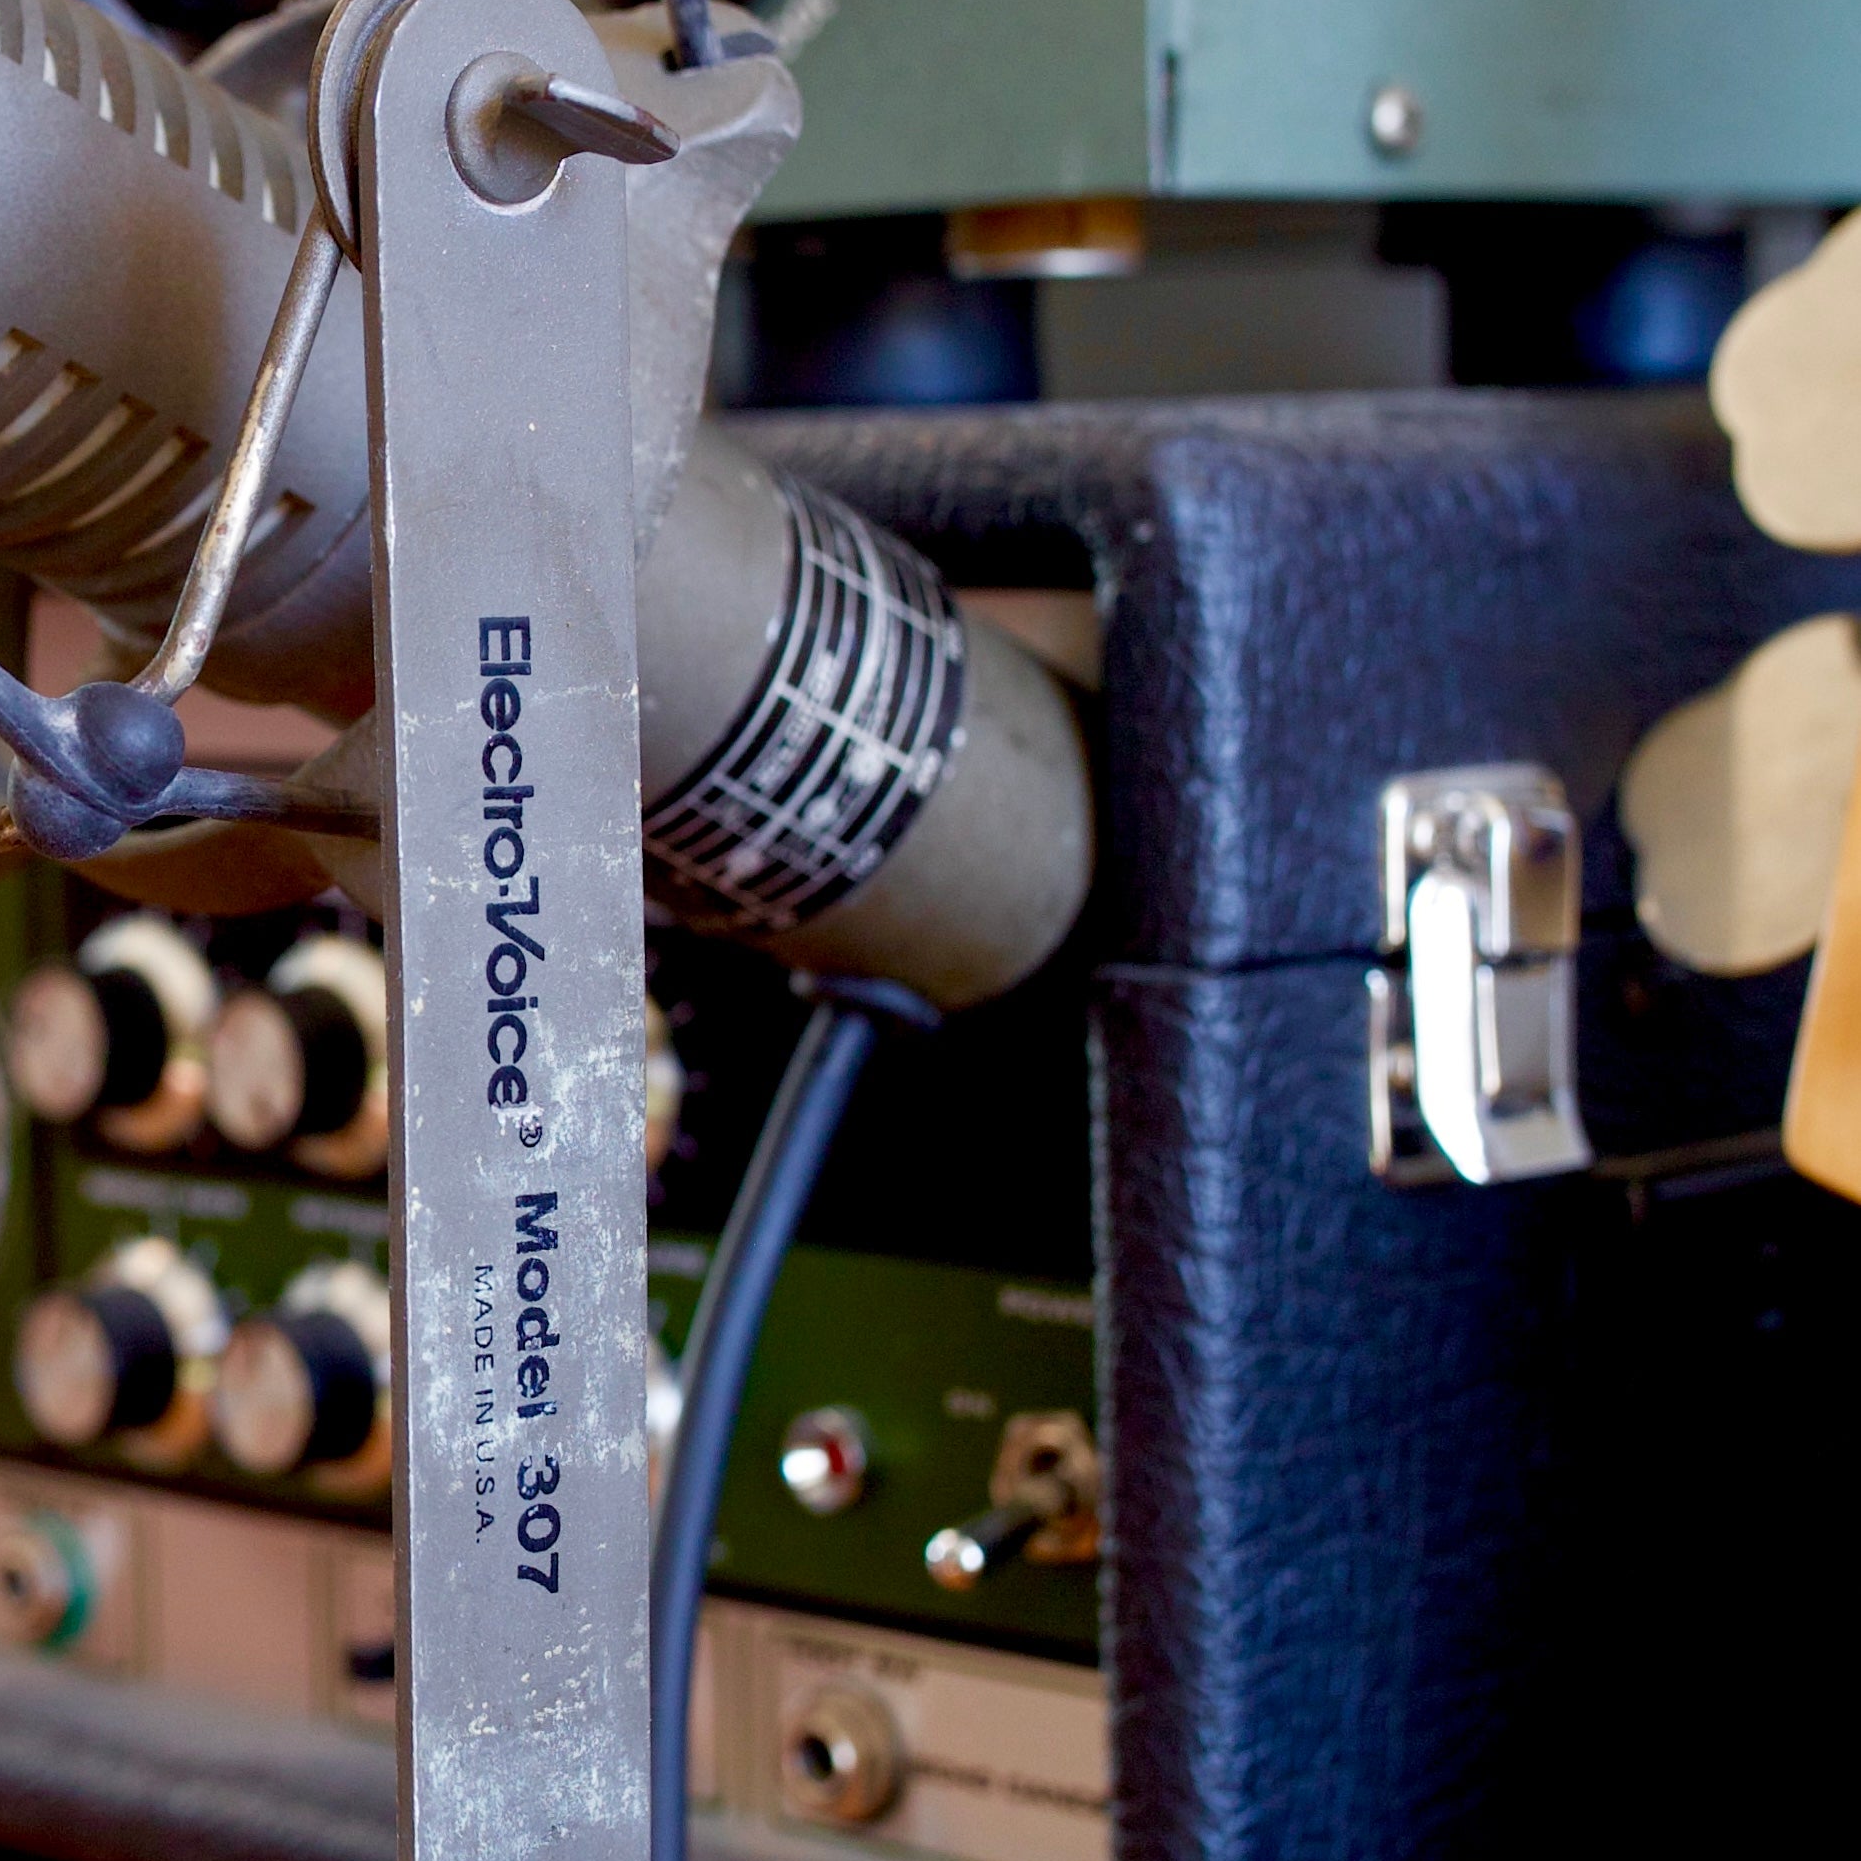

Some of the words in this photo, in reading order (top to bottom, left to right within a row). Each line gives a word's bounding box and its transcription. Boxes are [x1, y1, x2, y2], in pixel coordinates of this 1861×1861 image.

[473, 1264, 494, 1374] MADE
[515, 1191, 560, 1419] Model
[474, 1388, 494, 1426] IN
[475, 1442, 495, 1545] U.S.A.
[516, 1453, 561, 1594] 307
